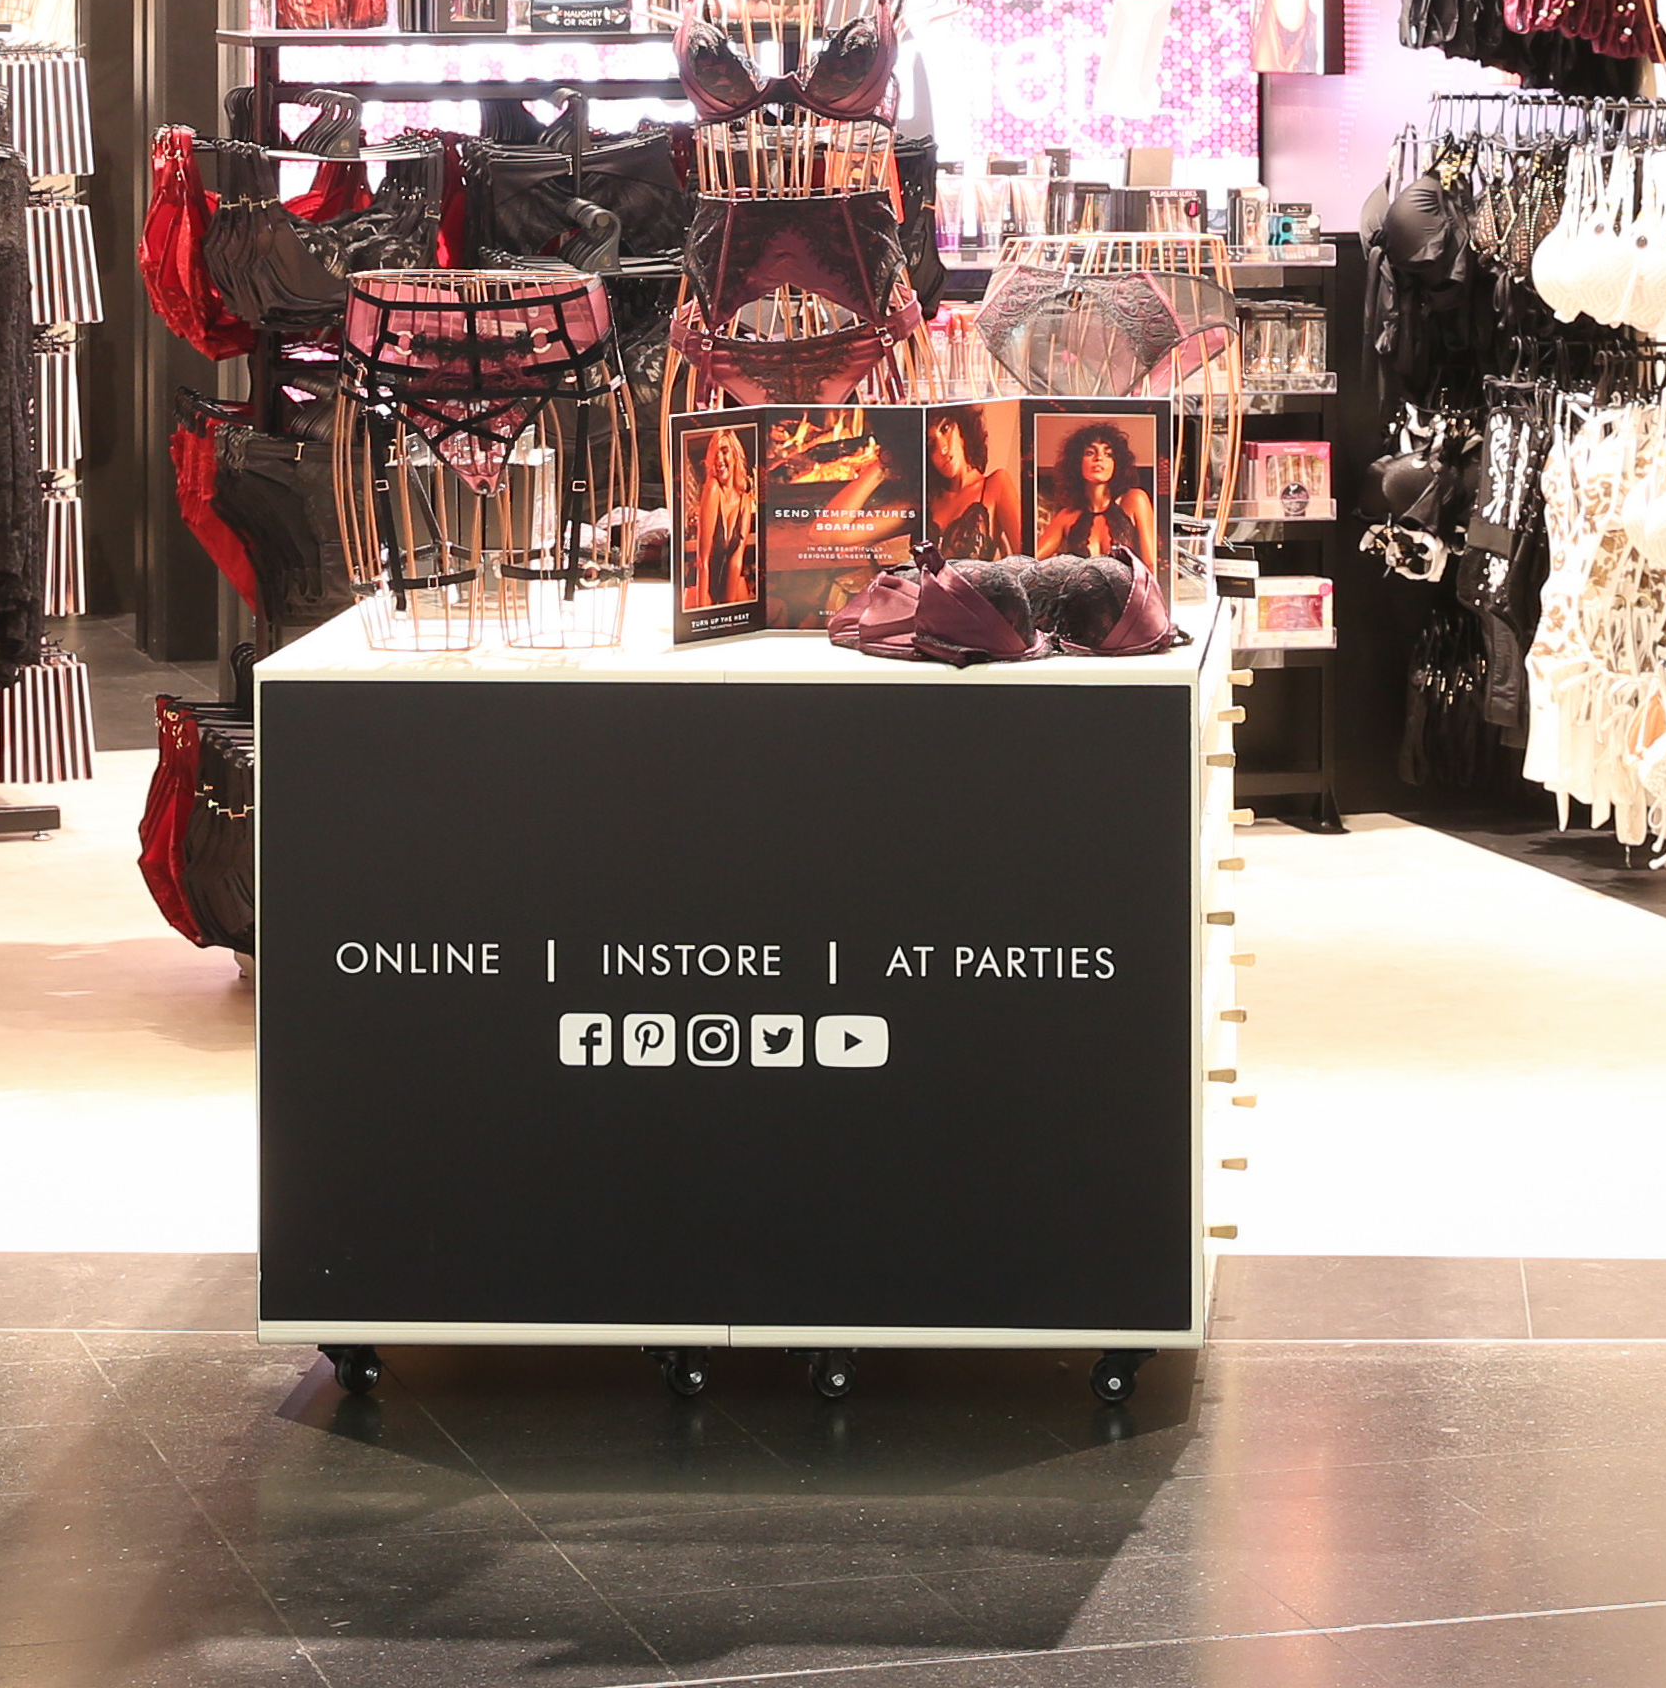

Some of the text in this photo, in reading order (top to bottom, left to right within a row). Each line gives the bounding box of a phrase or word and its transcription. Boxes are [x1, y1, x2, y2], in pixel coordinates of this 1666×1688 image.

[563, 10, 602, 18] NAUGHTY
[563, 18, 602, 26] OR NICE?
[775, 509, 916, 519] SEND TEMPERATURES
[816, 522, 875, 531] SOARING
[691, 619, 709, 629] TURN
[710, 617, 720, 625] UP
[720, 615, 732, 623] THE
[733, 613, 750, 621] HEAT
[335, 941, 1116, 980] ONLINE INSTORE AT PARTIES
